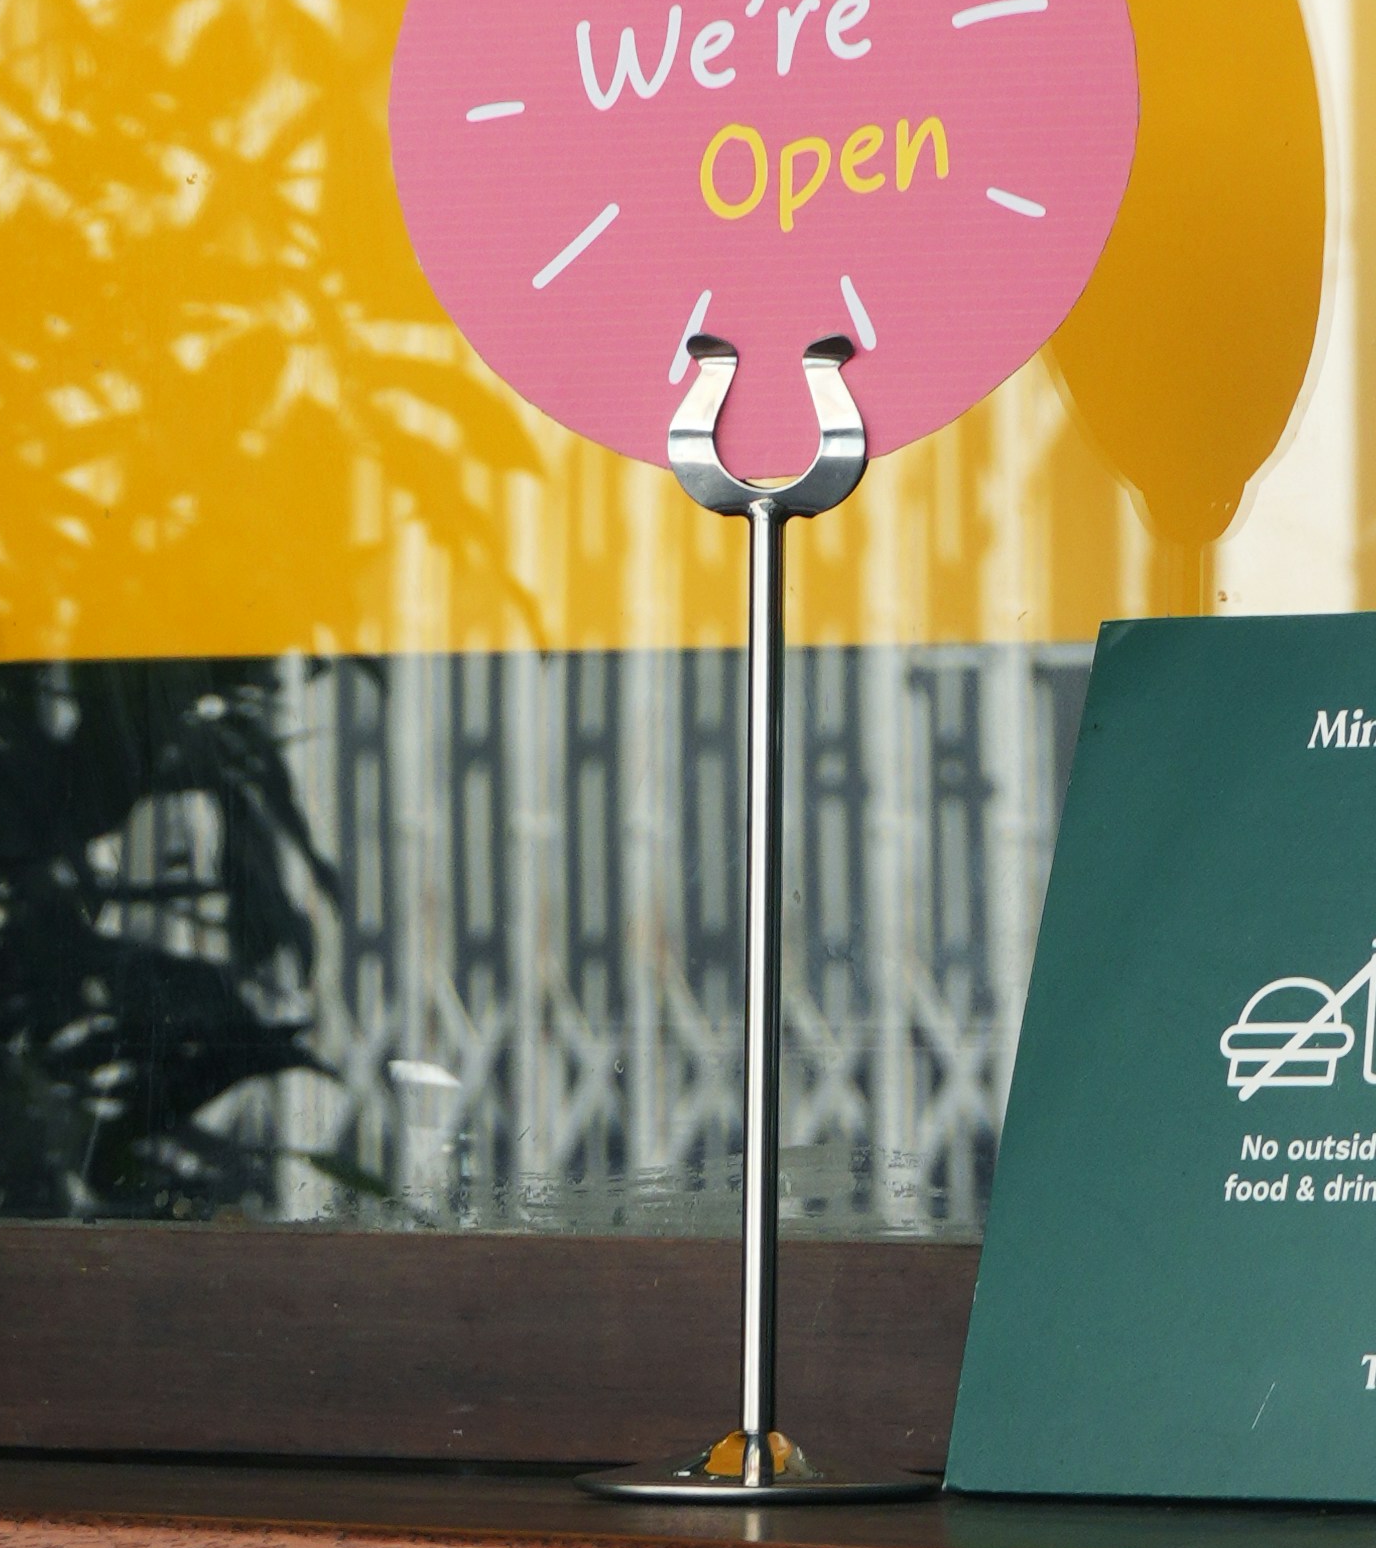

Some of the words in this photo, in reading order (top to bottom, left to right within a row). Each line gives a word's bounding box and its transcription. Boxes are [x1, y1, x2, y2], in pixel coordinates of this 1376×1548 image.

[700, 116, 950, 233] Open
[1241, 1135, 1278, 1161] No
[1224, 1174, 1288, 1202] food
[1296, 1176, 1315, 1202] &
